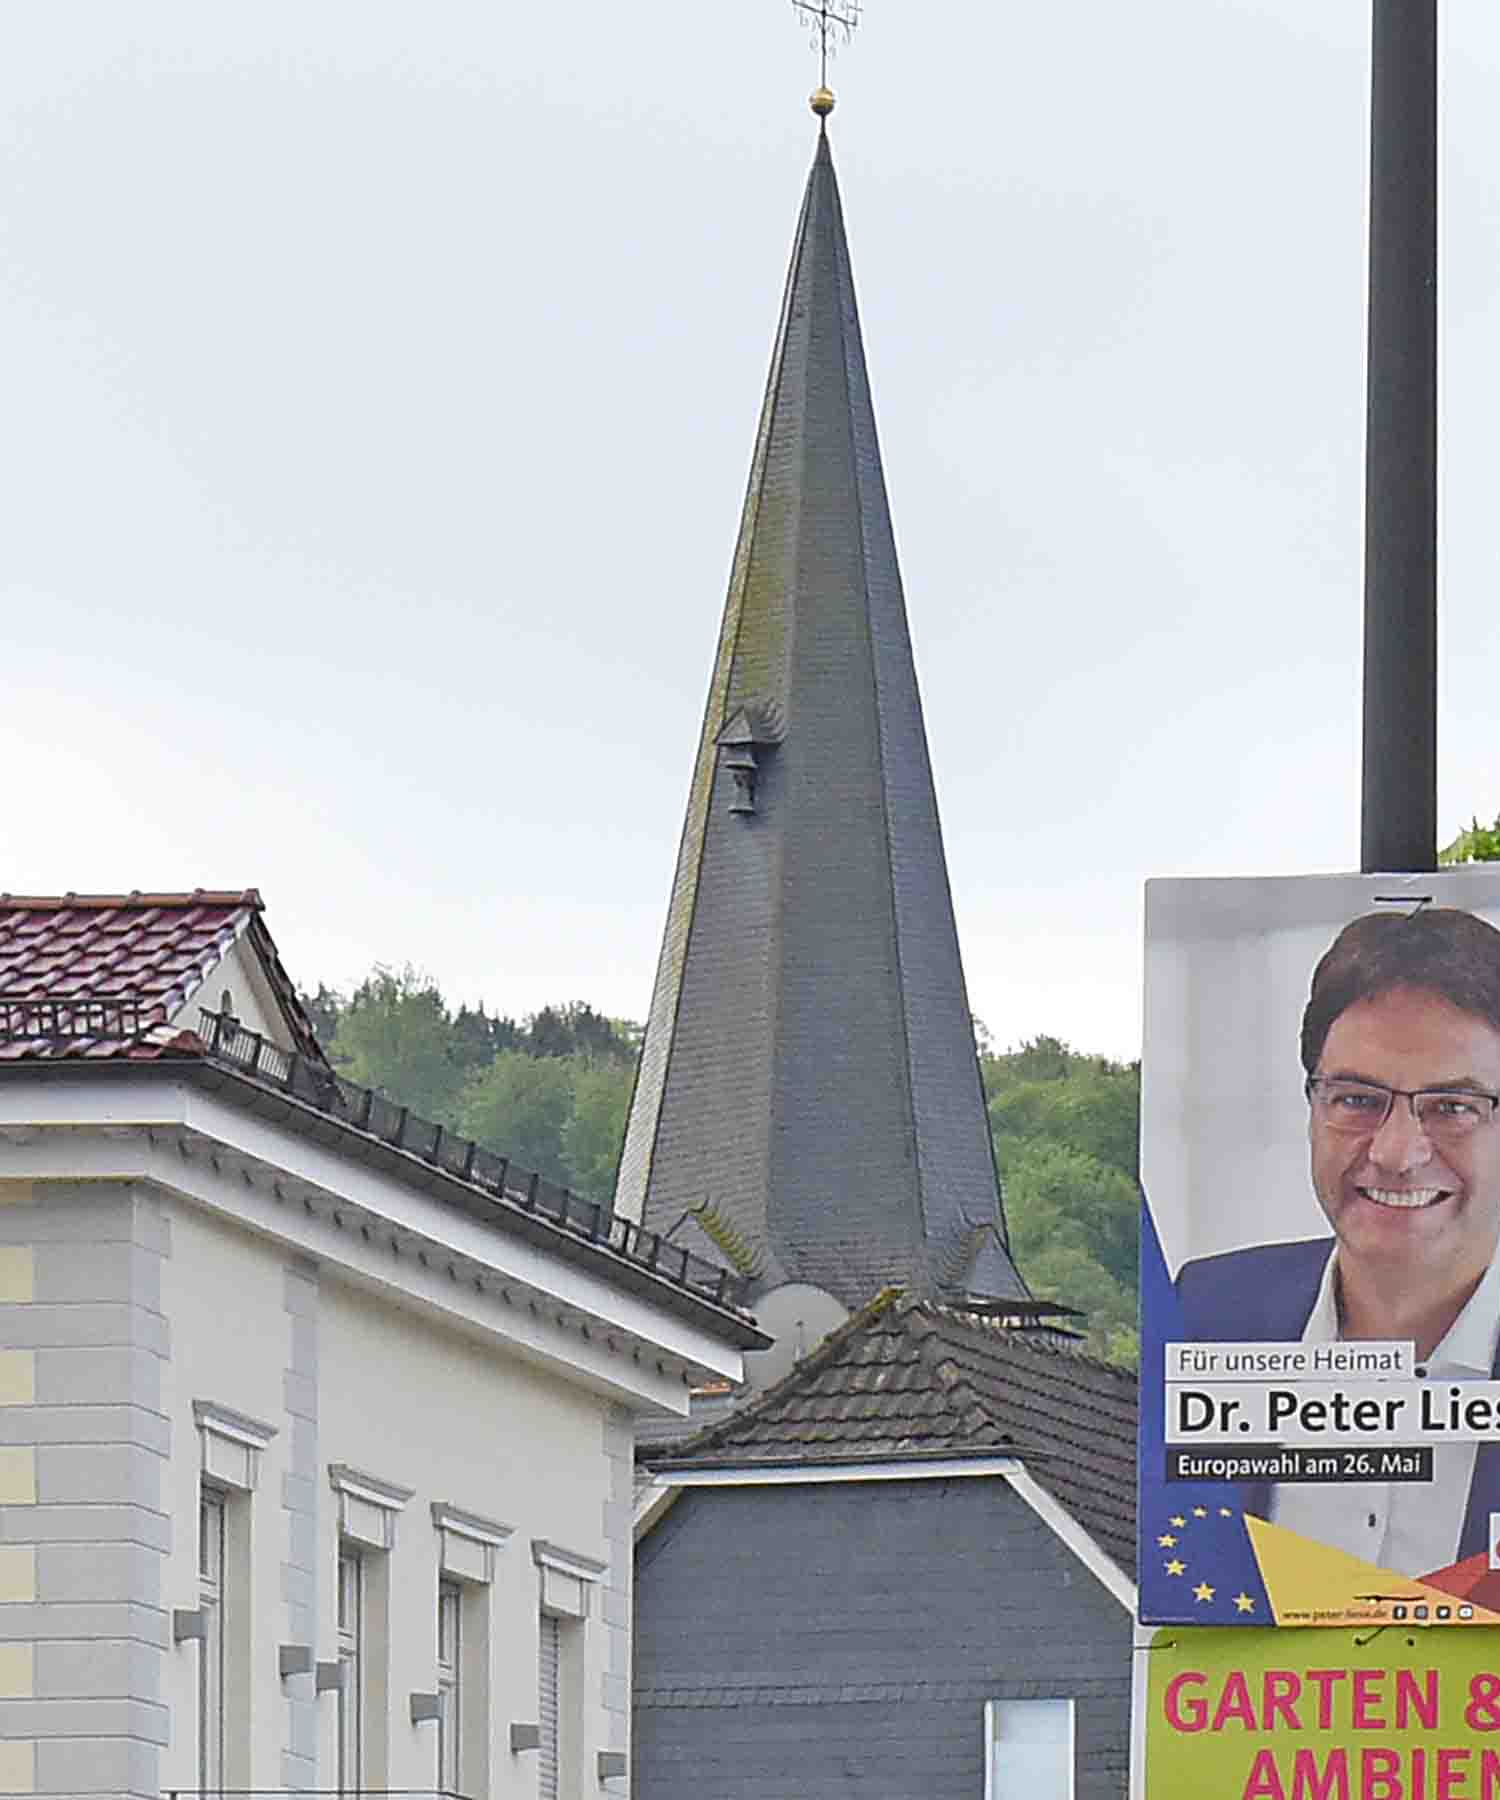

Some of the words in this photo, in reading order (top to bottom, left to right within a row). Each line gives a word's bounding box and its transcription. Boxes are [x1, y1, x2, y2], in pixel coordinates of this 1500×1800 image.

[1179, 1350, 1218, 1372] Für
[1226, 1354, 1306, 1372] unsere
[1314, 1349, 1403, 1371] Heimat
[1179, 1391, 1250, 1432] Dr.
[1268, 1390, 1405, 1432] Peter
[1178, 1453, 1300, 1480] Europawahl
[1305, 1458, 1338, 1475] am
[1343, 1454, 1376, 1475] 26.
[1381, 1453, 1421, 1474] Mai
[1163, 1669, 1439, 1732] GARTEN
